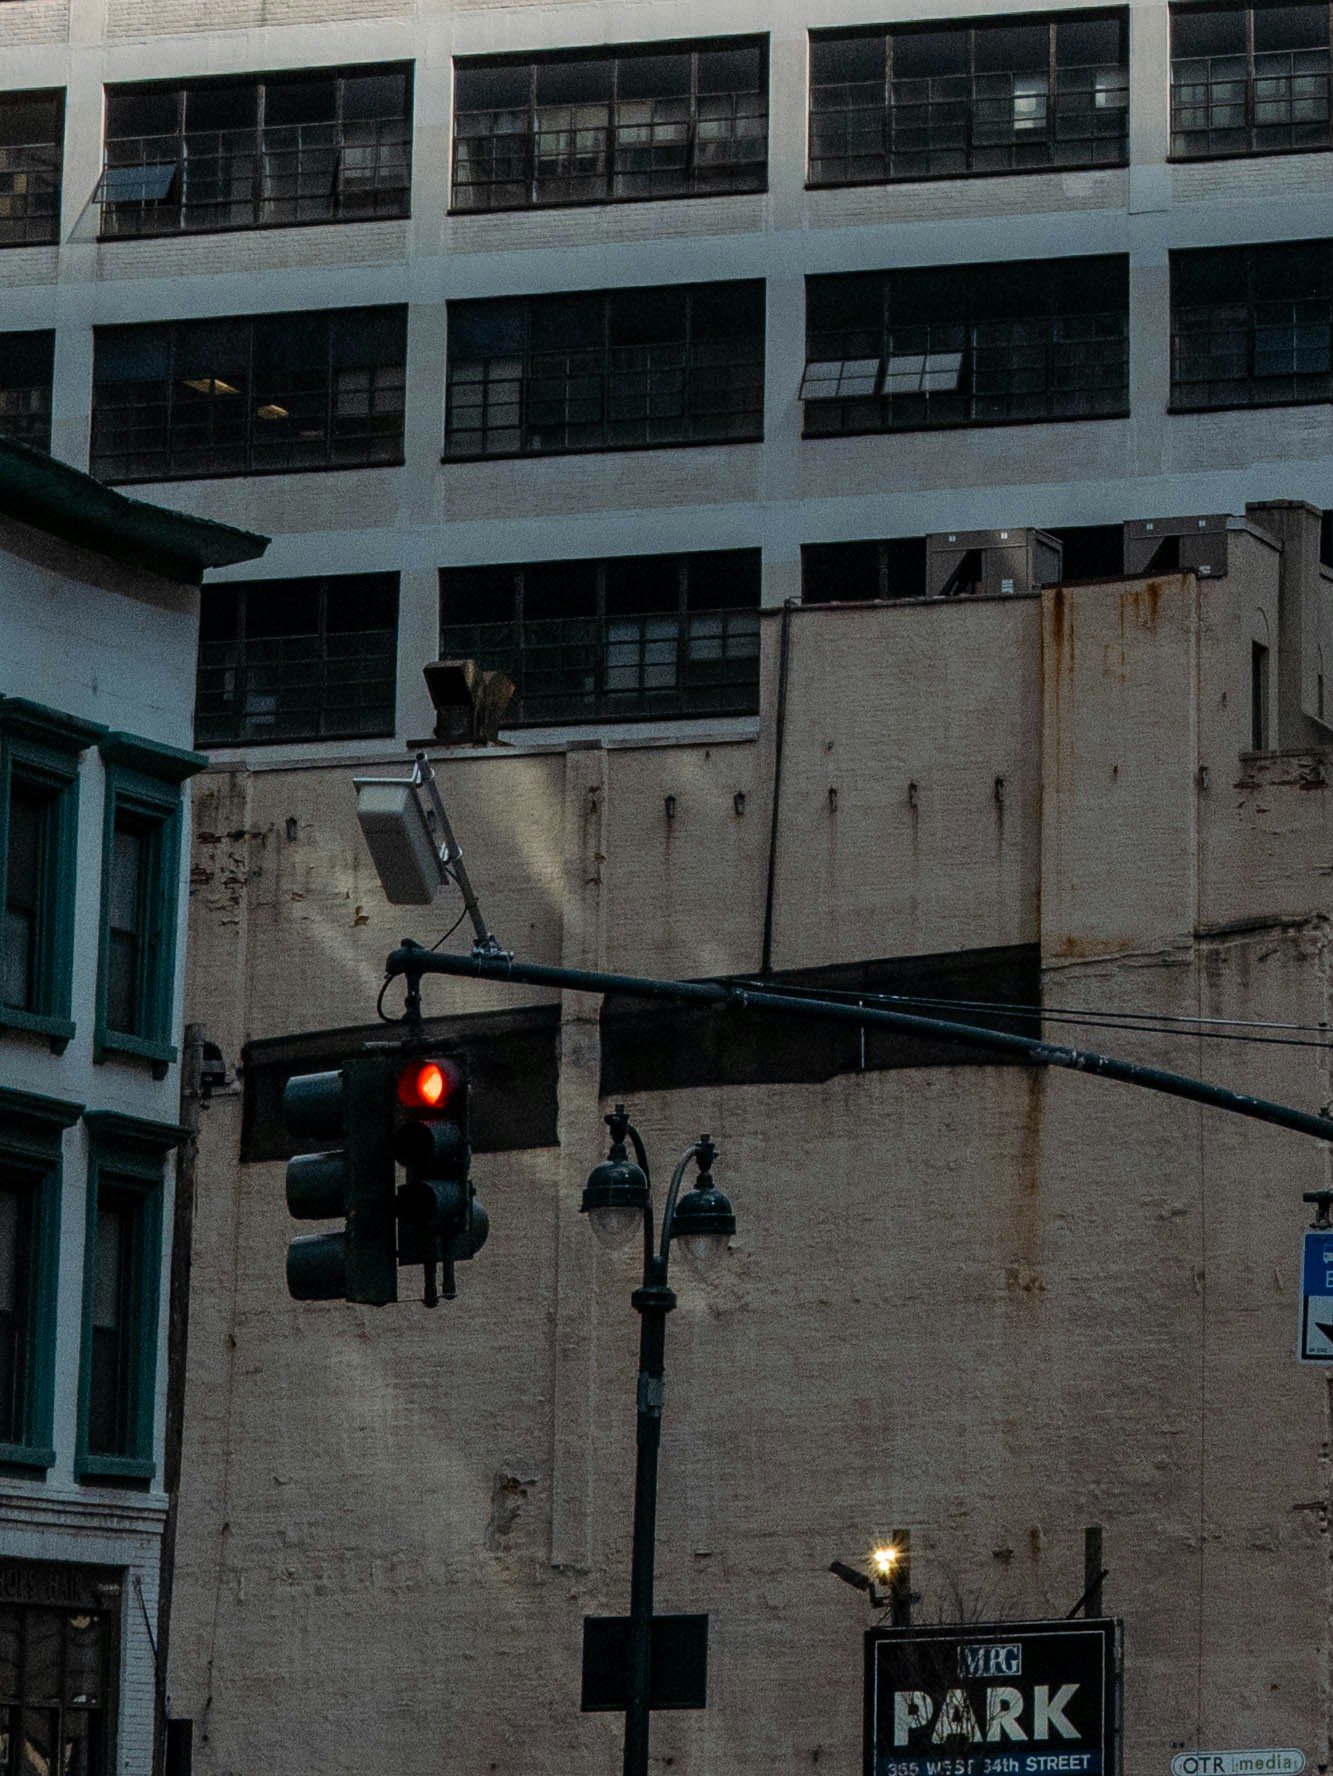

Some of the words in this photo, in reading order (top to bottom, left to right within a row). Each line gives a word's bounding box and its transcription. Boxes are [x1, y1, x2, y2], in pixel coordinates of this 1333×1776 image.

[893, 1683, 1082, 1747] PARK
[926, 1758, 976, 1776] WEST
[983, 1756, 1019, 1775] 34th
[1026, 1753, 1092, 1773] STREET
[1182, 1756, 1226, 1776] OTR
[1239, 1753, 1293, 1772] media
